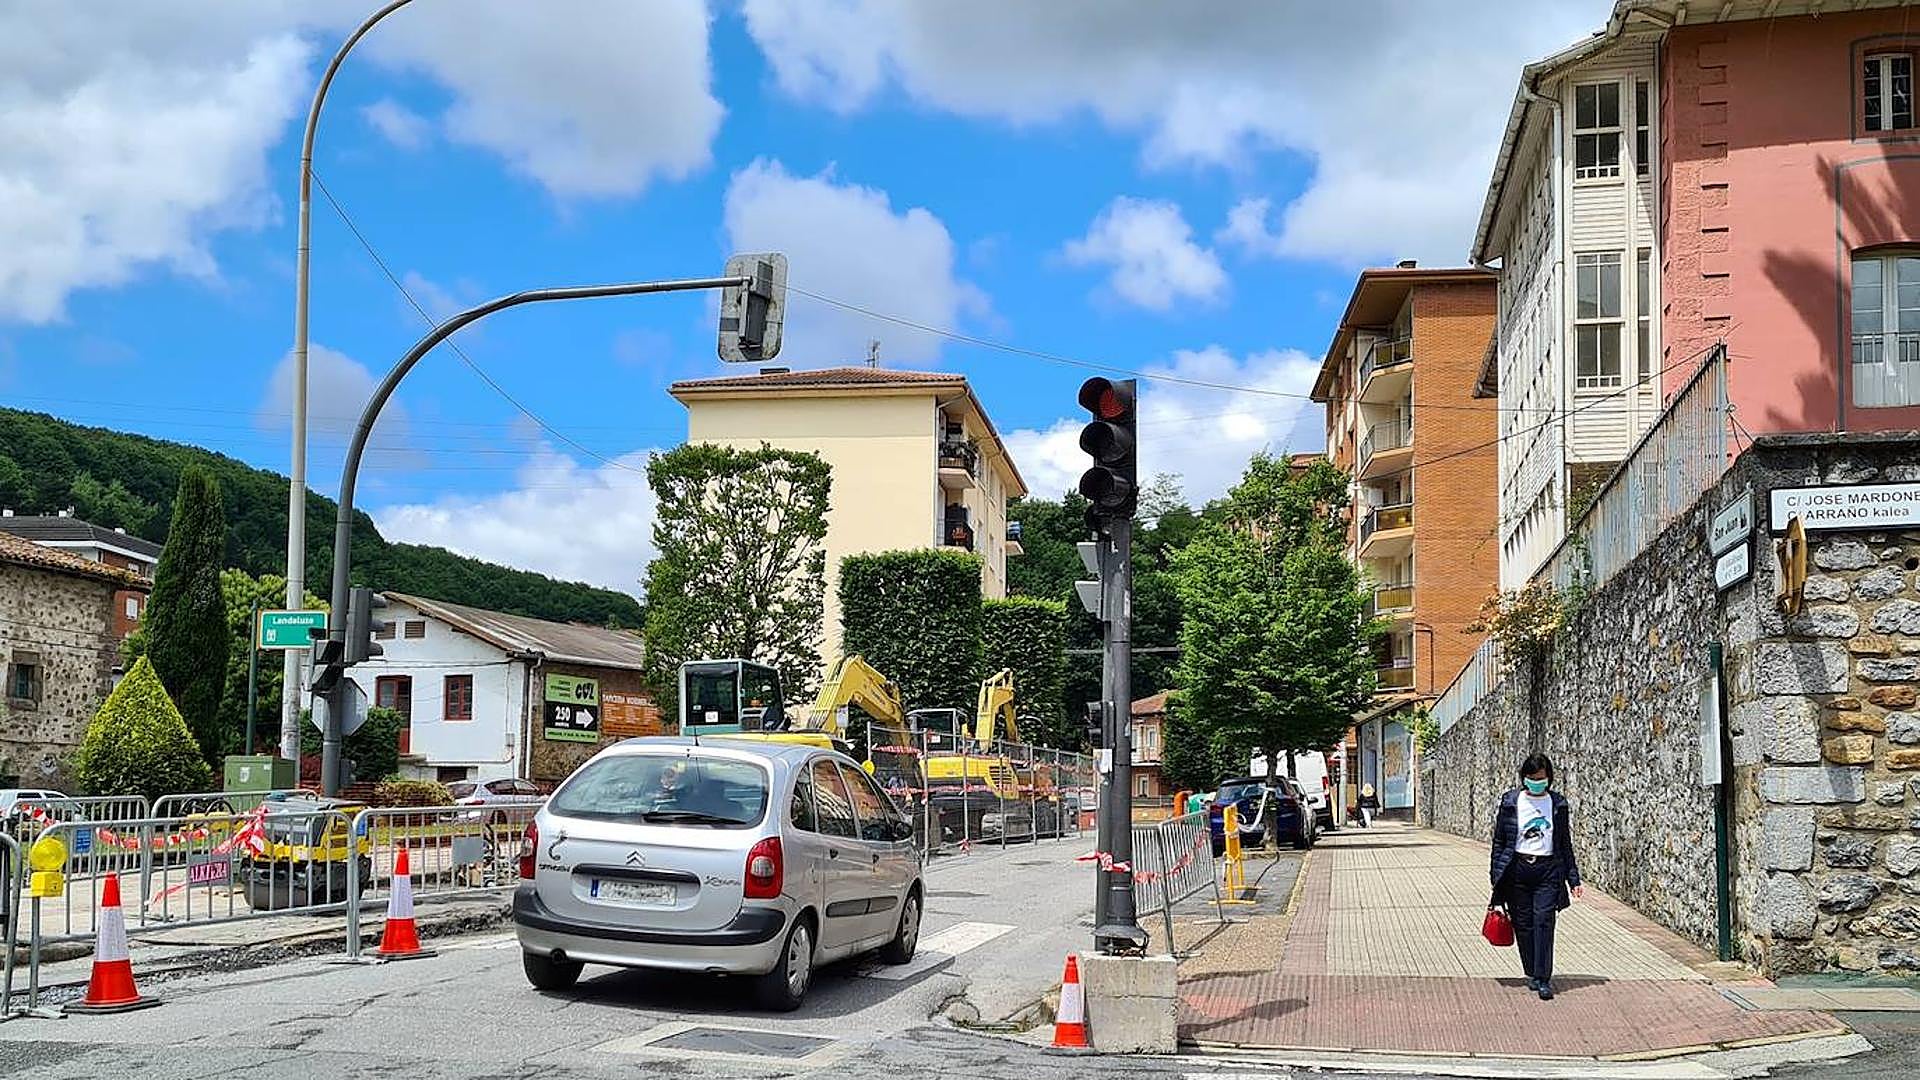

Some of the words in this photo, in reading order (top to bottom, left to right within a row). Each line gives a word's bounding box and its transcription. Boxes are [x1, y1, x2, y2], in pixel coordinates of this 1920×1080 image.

[1786, 496, 1801, 506] C/
[1805, 494, 1843, 506] JOSE
[1805, 506, 1869, 520] ARRAÑO
[1873, 506, 1910, 518] kalea
[555, 705, 571, 721] 250
